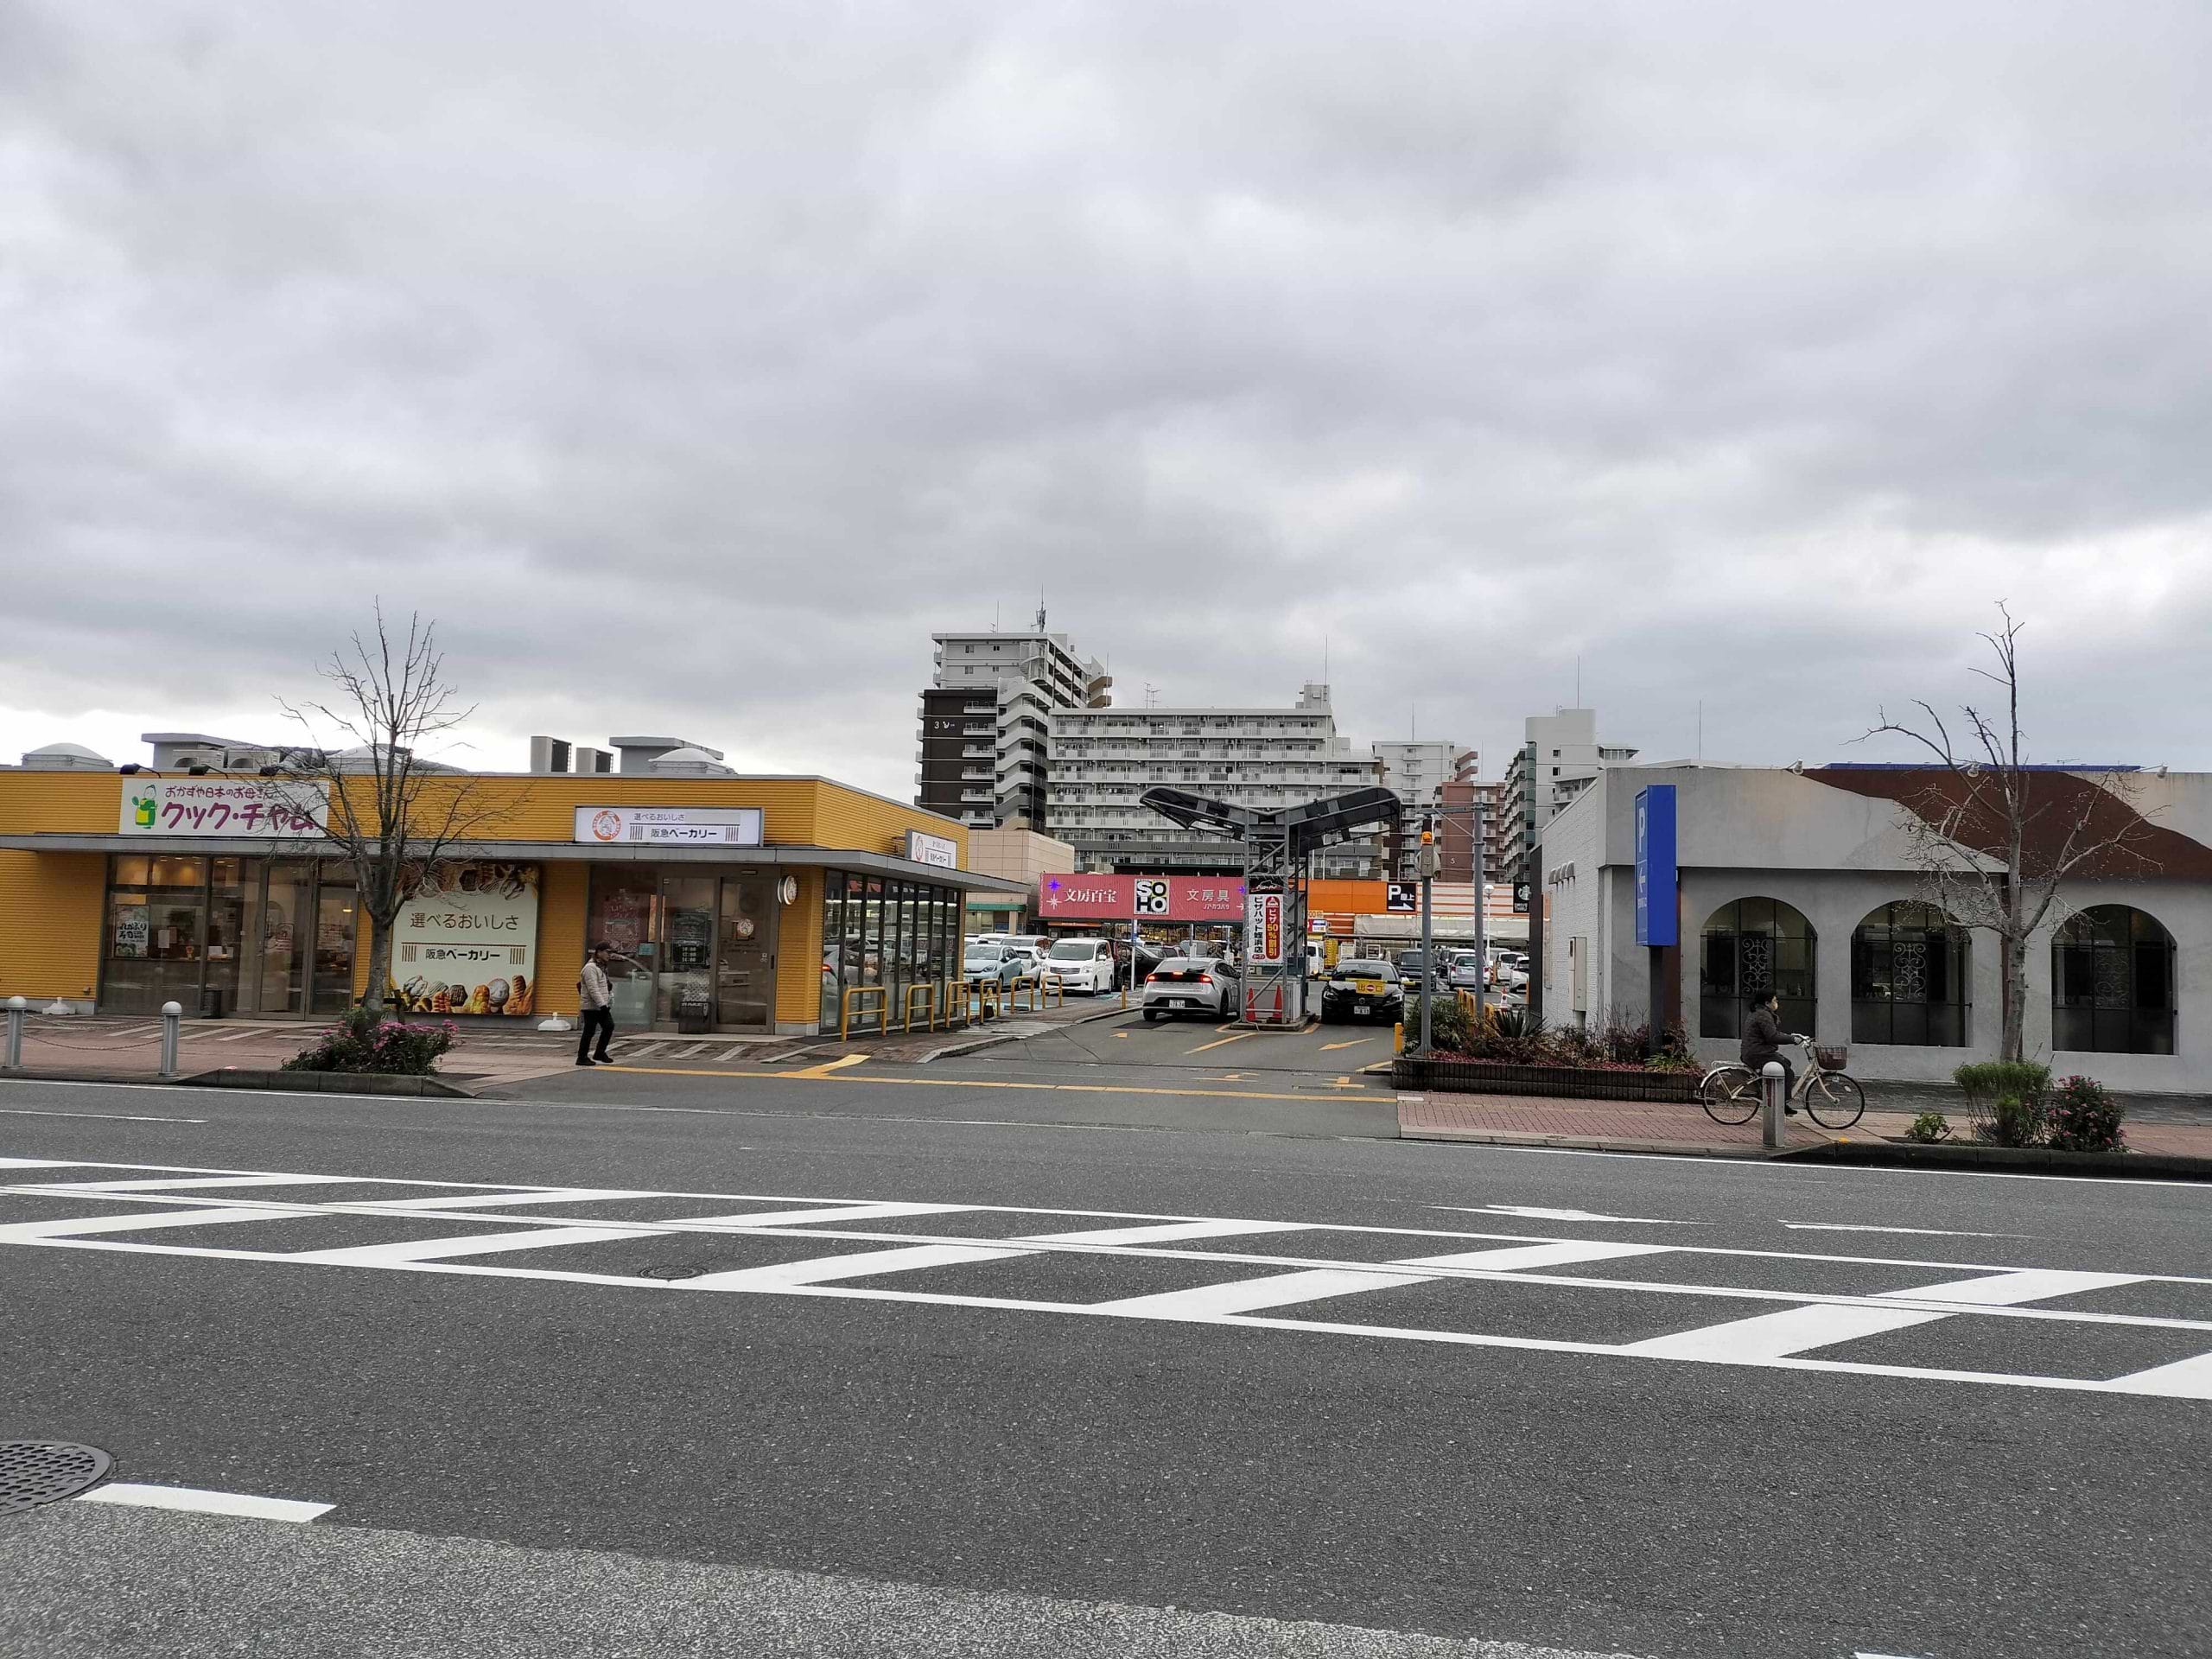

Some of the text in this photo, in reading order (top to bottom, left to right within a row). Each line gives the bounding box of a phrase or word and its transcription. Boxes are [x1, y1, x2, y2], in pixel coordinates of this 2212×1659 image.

[633, 813, 685, 822] 選べるおいしさ
[651, 829, 717, 838] 阪急ベーカリー
[1638, 807, 1646, 853] P
[1064, 888, 1117, 903] 文房百宝
[1186, 888, 1230, 902] 文房具
[1388, 884, 1402, 901] P
[410, 912, 519, 931] 選べるおいしさ
[425, 949, 501, 961] 阪急ベーカリー
